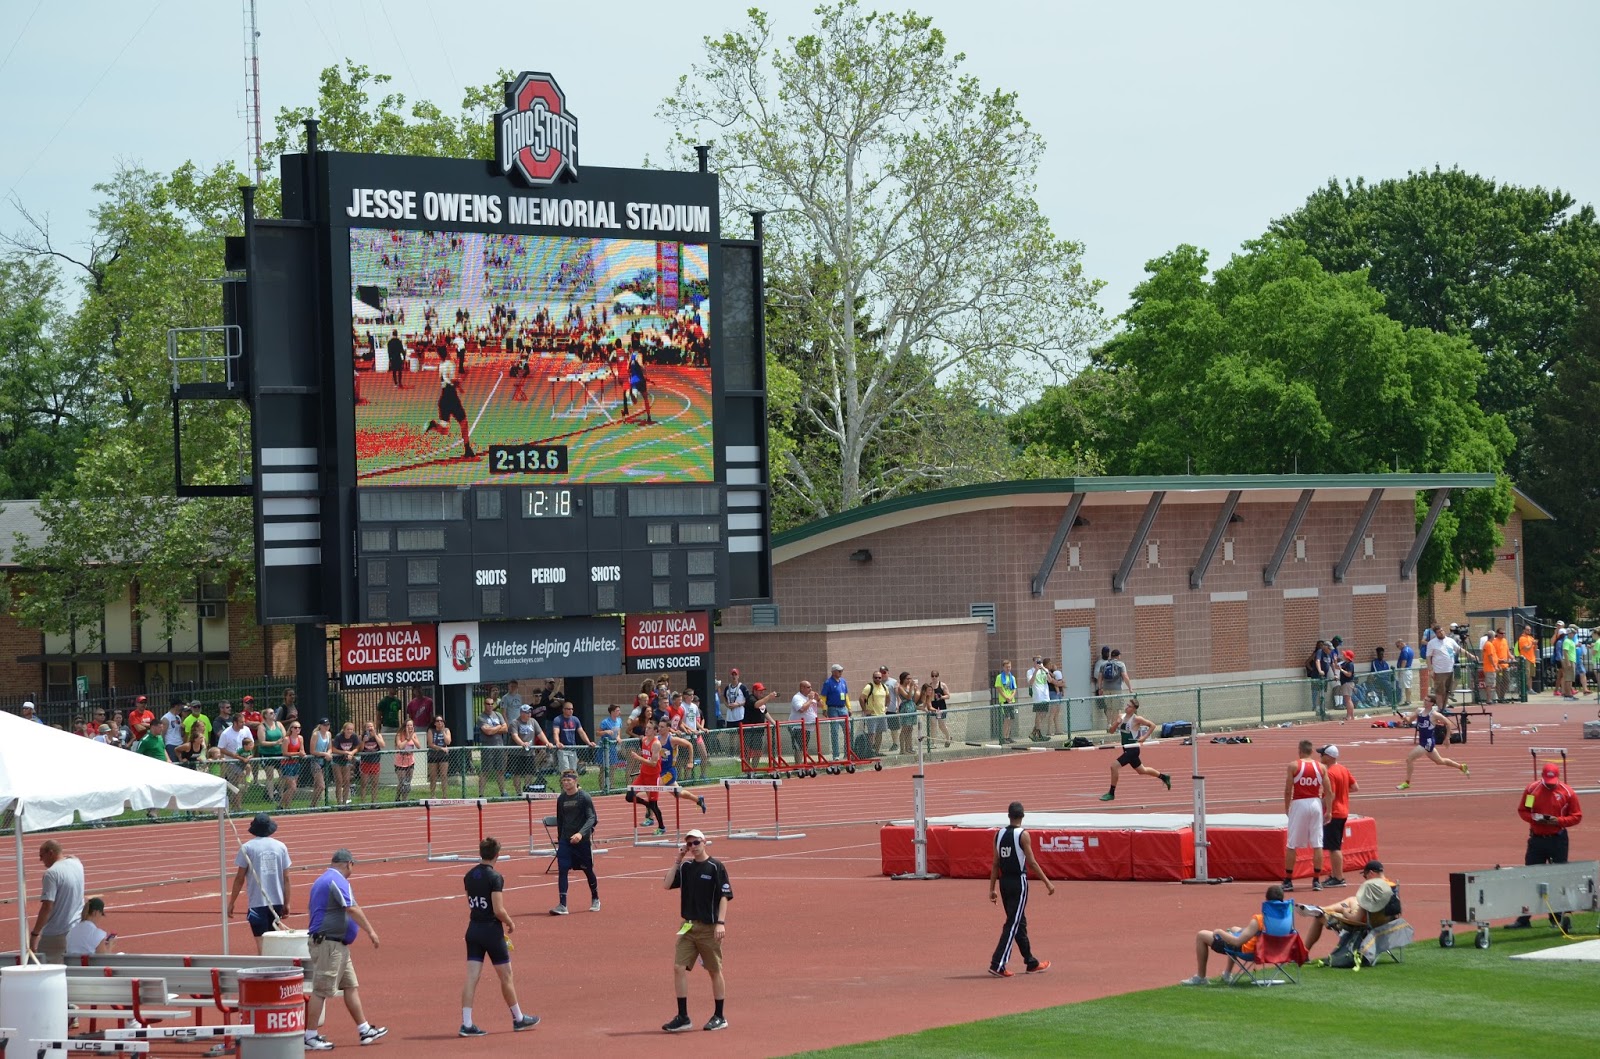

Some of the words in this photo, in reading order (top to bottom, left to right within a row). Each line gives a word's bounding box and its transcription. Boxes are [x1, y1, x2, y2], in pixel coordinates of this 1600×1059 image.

[346, 188, 417, 220] JESSE
[423, 191, 502, 224] OWENS
[508, 196, 621, 229] MEMORIAL
[626, 202, 711, 233] STADIUM
[496, 450, 559, 470] 2:13.6
[529, 490, 571, 516] 12:18
[475, 569, 507, 586] SHOTS
[531, 567, 567, 584] PERIOD
[591, 565, 621, 581] SHOTS
[638, 620, 663, 634] 2007
[666, 618, 696, 632] NCAA
[357, 632, 383, 647] 2010
[386, 630, 421, 646] NCAA
[631, 634, 681, 650] COLLEGE
[682, 633, 705, 647] CUP
[347, 647, 403, 664] COLLEGE
[406, 646, 431, 662] CUP
[483, 640, 527, 658] Athletes
[530, 638, 571, 659] Helping
[493, 657, 544, 665] ohiostatebuckeyes.com
[637, 657, 665, 670] MEN'S
[666, 655, 700, 669] SOCCER
[345, 671, 394, 686] WOMEN'S
[395, 669, 434, 684] SOCCER
[1040, 836, 1084, 848] UCS
[468, 896, 488, 909] 315
[163, 1028, 197, 1037] UCS
[75, 1042, 102, 1050] UCS
